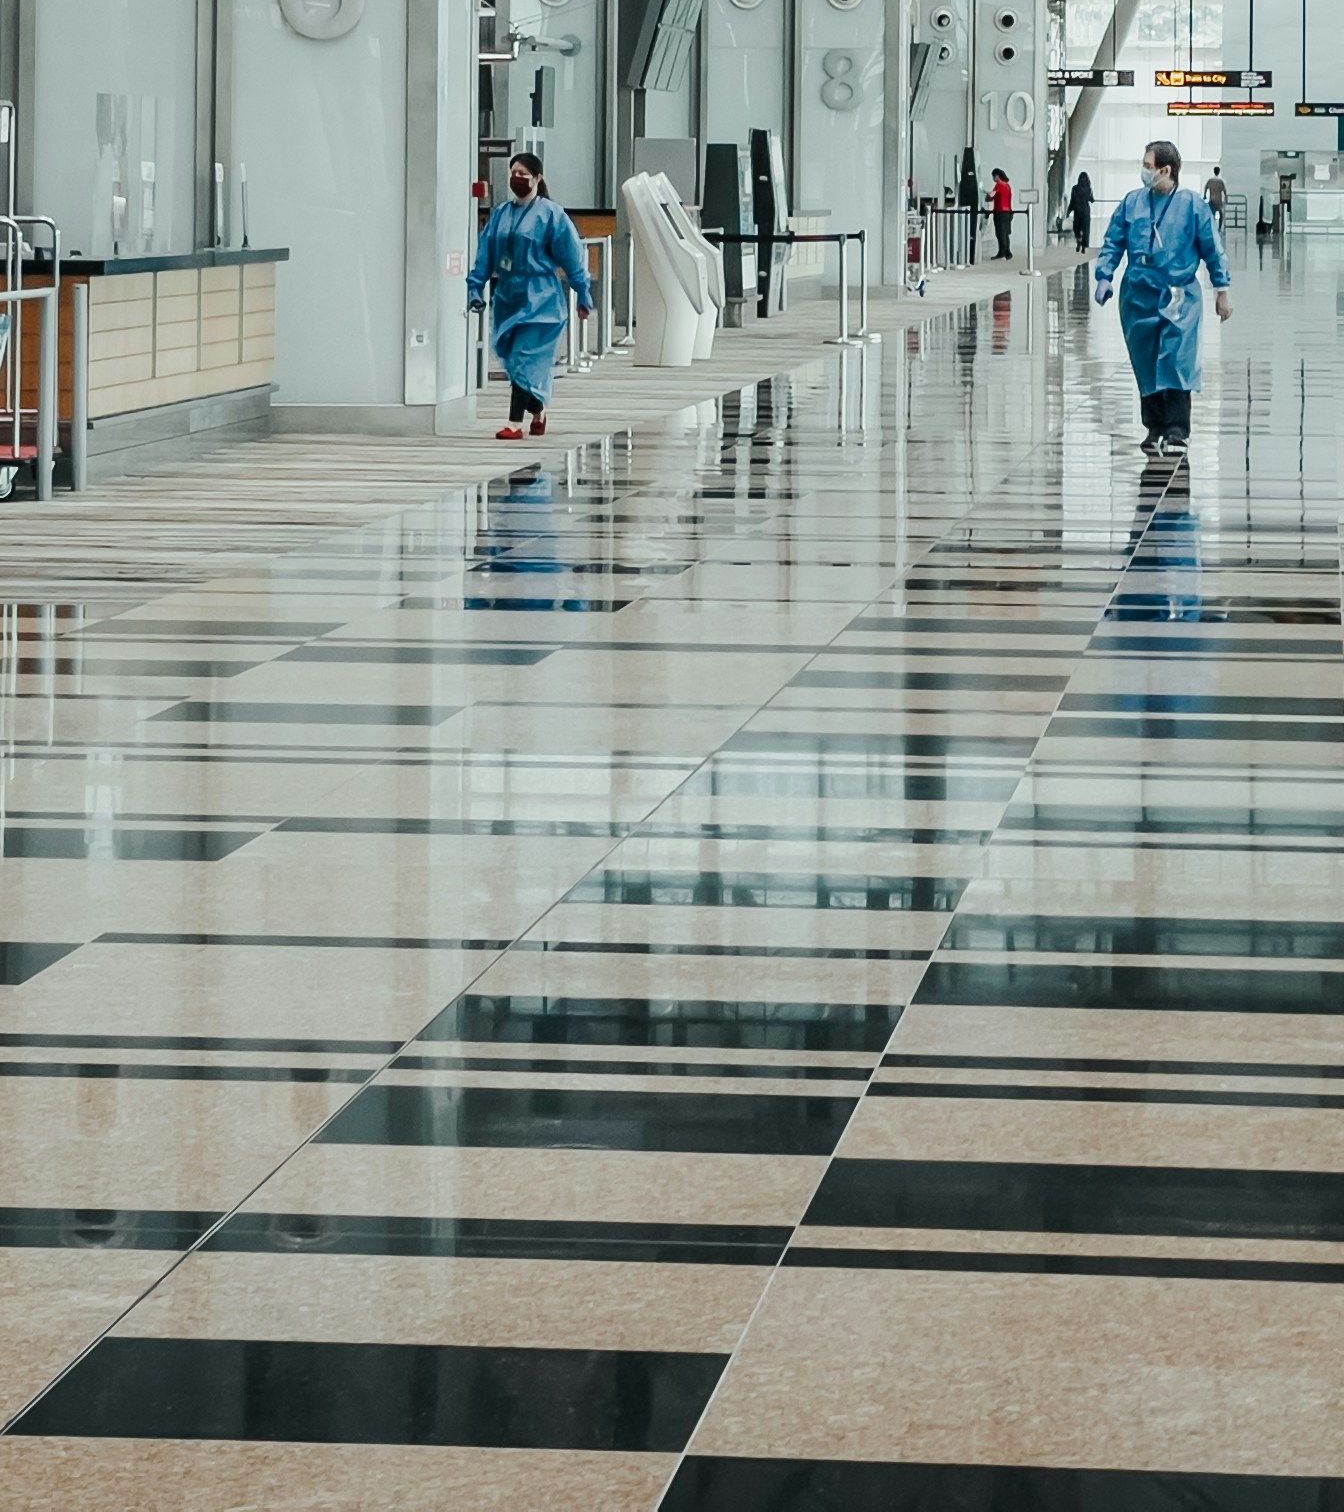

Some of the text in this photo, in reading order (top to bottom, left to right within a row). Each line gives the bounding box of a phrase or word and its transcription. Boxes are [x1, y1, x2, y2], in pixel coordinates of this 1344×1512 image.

[821, 48, 864, 112] 8
[1185, 74, 1226, 84] Train to City
[980, 90, 1036, 133] 10
